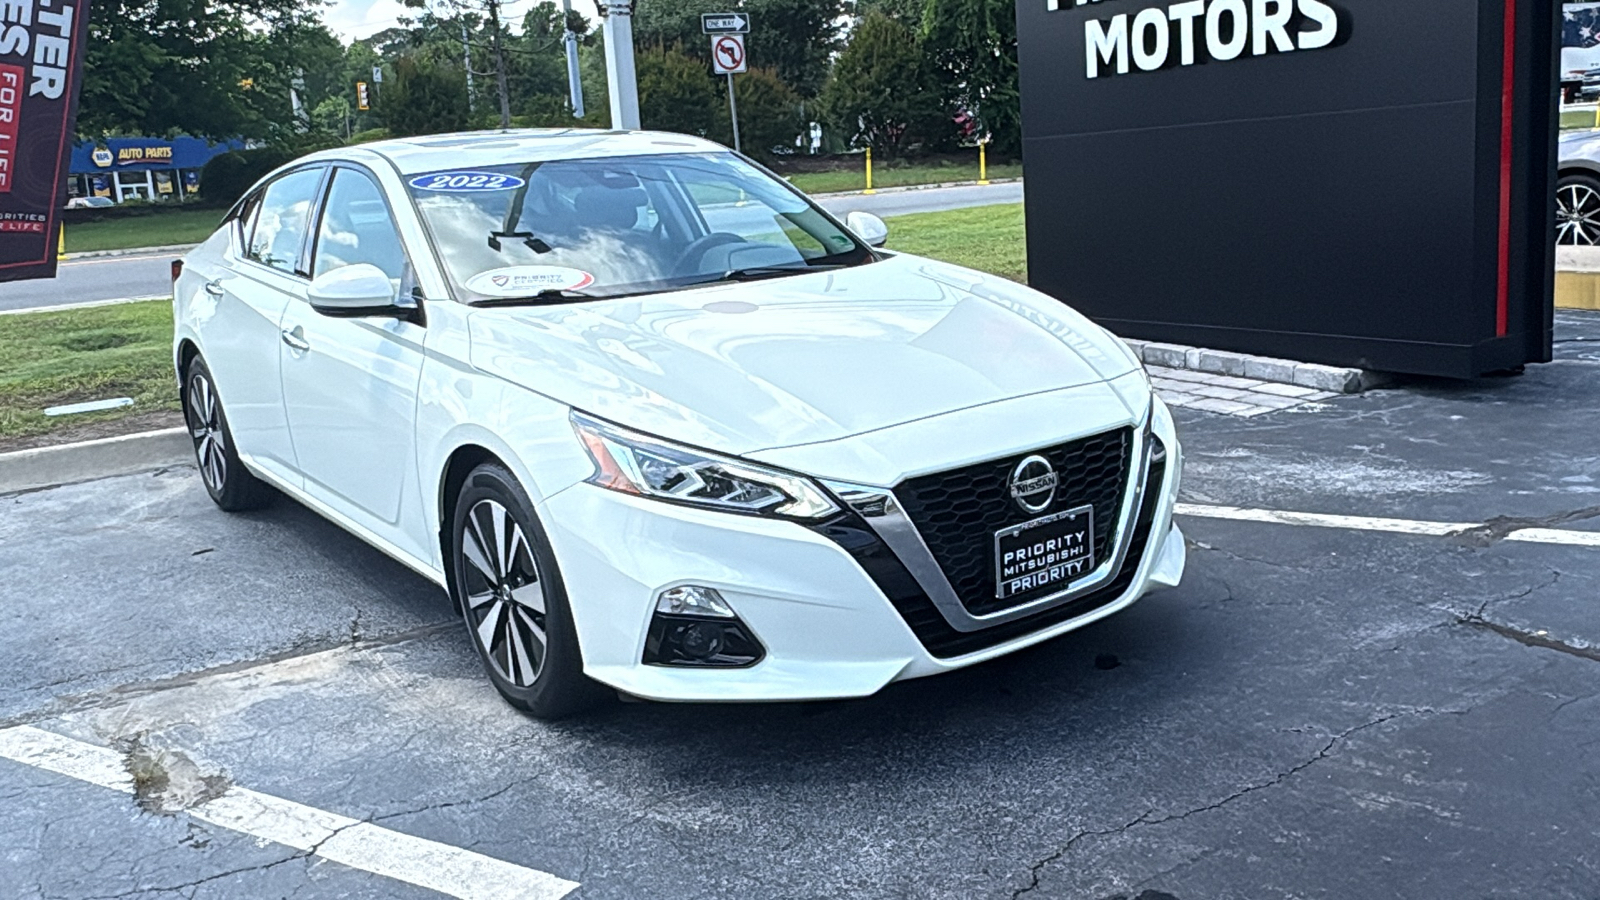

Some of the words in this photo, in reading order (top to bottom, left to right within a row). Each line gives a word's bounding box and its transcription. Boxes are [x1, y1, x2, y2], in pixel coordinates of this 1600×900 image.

[708, 20, 720, 28] ONE
[29, 0, 74, 99] TER
[1085, 0, 1338, 79] MOTORS
[118, 147, 143, 160] AUTO
[145, 146, 173, 158] PARTS
[427, 175, 508, 188] 2022
[9, 222, 41, 231] LIFE
[1015, 475, 1056, 495] NISSAN
[1004, 531, 1085, 565] PRIORITY
[1004, 545, 1084, 577] MITSUBISHI
[1011, 560, 1084, 594] PRIORITY
